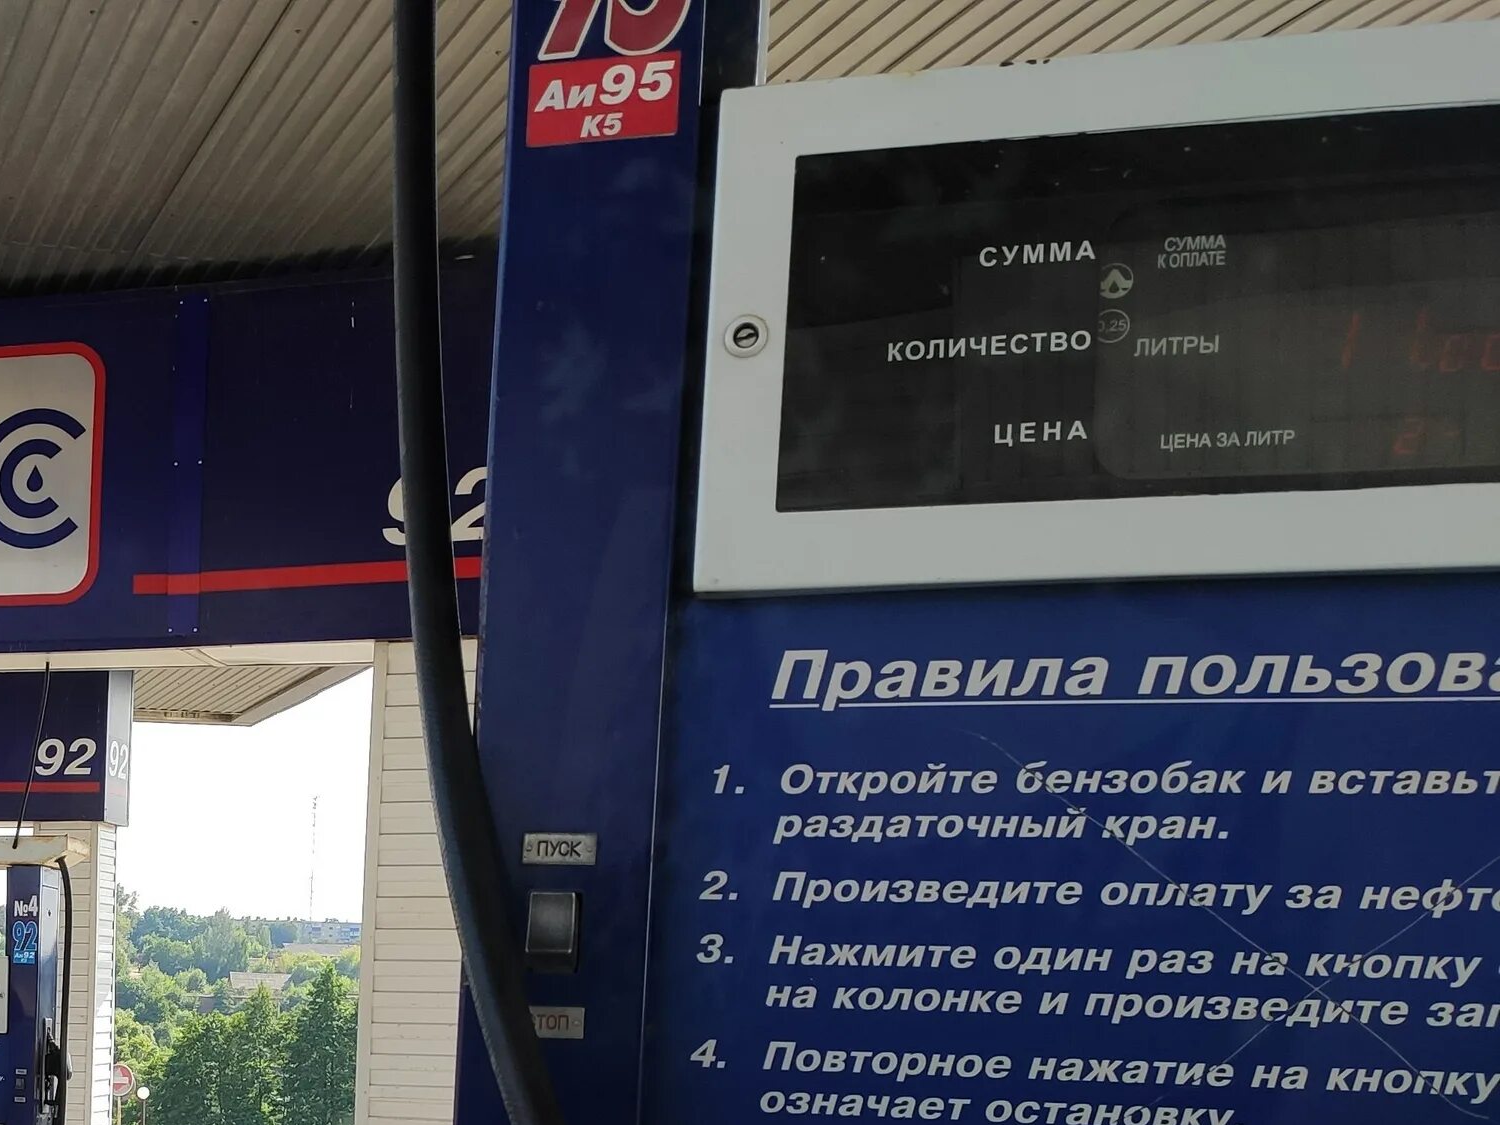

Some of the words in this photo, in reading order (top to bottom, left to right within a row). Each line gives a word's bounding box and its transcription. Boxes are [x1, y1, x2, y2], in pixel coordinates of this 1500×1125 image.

[534, 60, 676, 113] Аи95
[580, 112, 624, 138] К5
[979, 240, 1096, 267] СУММА
[1157, 253, 1167, 269] К
[1168, 250, 1226, 268] ОПЛАТЕ
[1164, 235, 1227, 253] СУММА
[887, 329, 1092, 362] КОЛИЧЕСТВО
[1134, 334, 1220, 358] ЛИТРЫ
[993, 420, 1088, 447] ЦЕНА
[1160, 433, 1210, 452] ЦЕНА
[1216, 431, 1240, 448] ЗА
[1244, 429, 1296, 448] ЛИТР
[770, 649, 1110, 712] Правила
[1137, 651, 1500, 696] пользова
[35, 738, 97, 776] 92
[108, 740, 129, 780] 92
[713, 763, 745, 795] 1.
[780, 762, 998, 801] Откройте
[1016, 760, 1246, 794] бензобак
[1260, 769, 1293, 794] и
[772, 807, 1087, 845] раздаточный
[1101, 815, 1229, 846] кран.
[536, 840, 583, 858] ПУСК
[14, 895, 39, 918] №4
[698, 870, 738, 901] 2.
[772, 871, 1084, 909] Произведите
[1100, 881, 1273, 915] оплату
[1285, 883, 1342, 909] за
[1358, 878, 1500, 919] нефт
[12, 920, 38, 951] 92
[695, 933, 734, 965] 3.
[768, 935, 977, 969] Нажмите
[993, 946, 1114, 976] один
[1125, 948, 1215, 980] раз
[1230, 951, 1290, 977] на
[1305, 953, 1483, 989] кнопку
[765, 984, 818, 1009] на
[832, 986, 1023, 1015] колонке
[1038, 992, 1070, 1015] и
[1084, 993, 1410, 1028] произведите
[533, 1013, 570, 1031] ТОП
[690, 1039, 727, 1069] 4.
[762, 1041, 1013, 1082] Повторное
[1028, 1056, 1235, 1088] нажатие
[1250, 1064, 1309, 1091] на
[759, 1090, 972, 1121] означает
